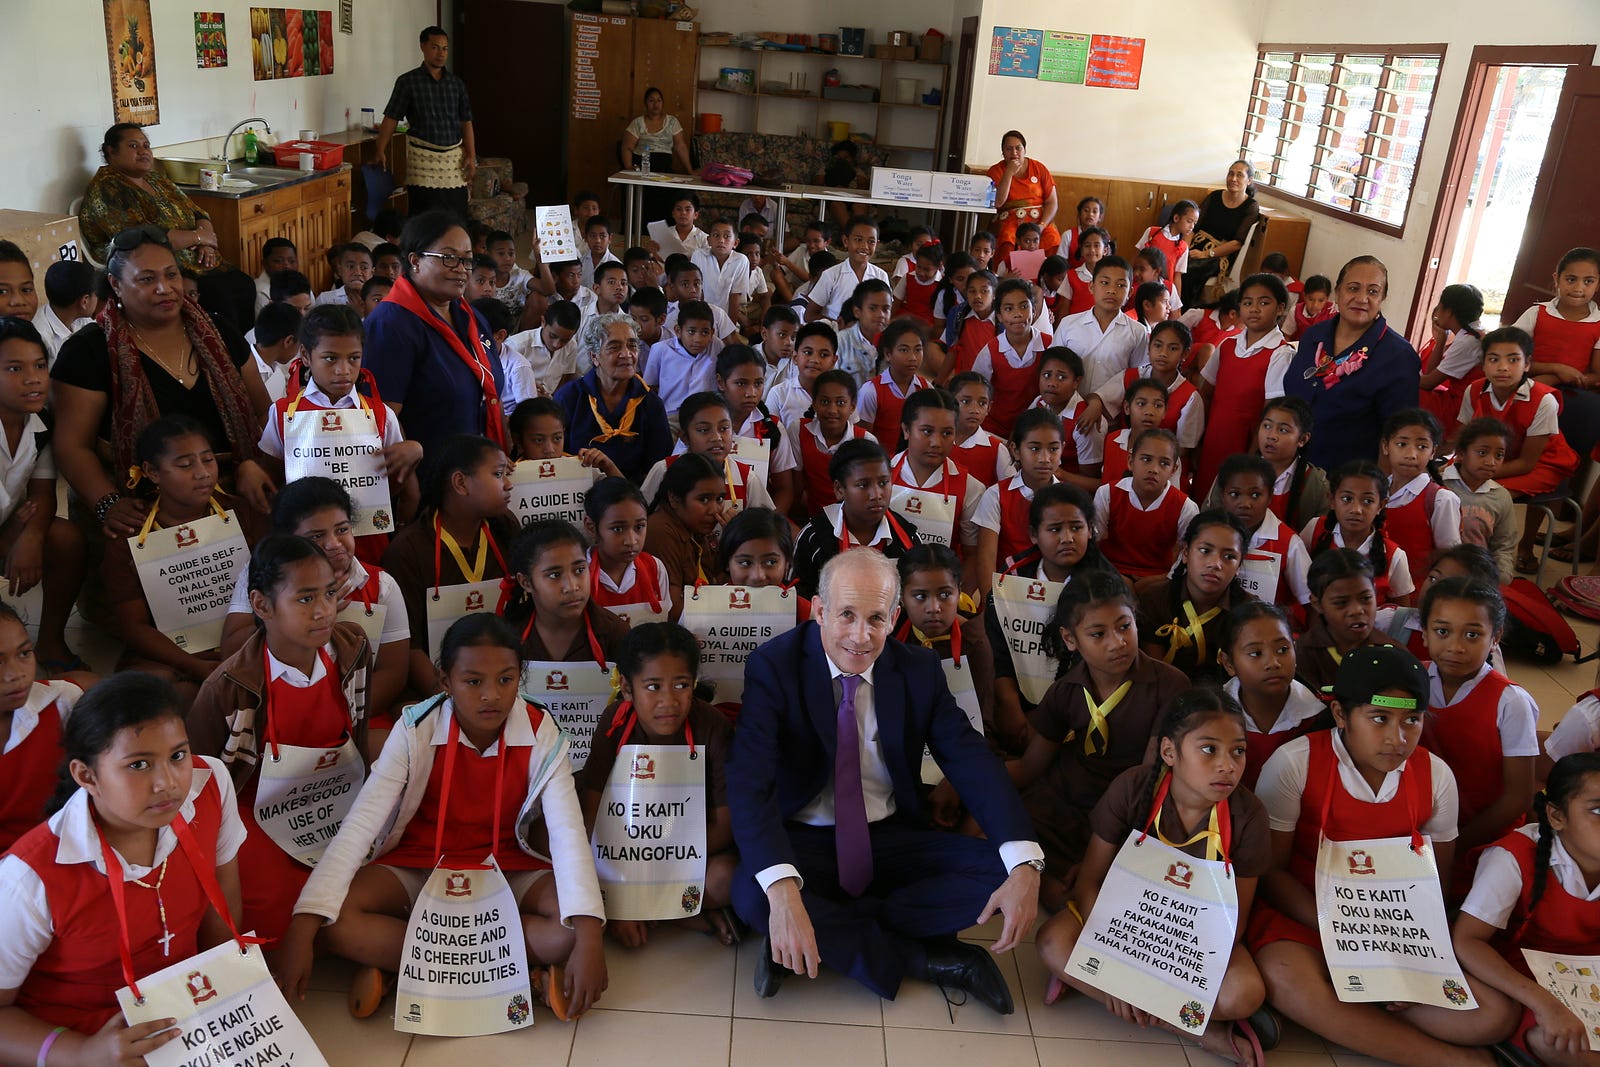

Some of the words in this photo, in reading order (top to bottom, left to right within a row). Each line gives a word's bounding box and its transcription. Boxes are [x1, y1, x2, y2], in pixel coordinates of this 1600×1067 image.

[891, 172, 912, 181] Tonga
[950, 178, 971, 186] Tonga
[294, 447, 330, 458] GUIDE
[520, 498, 528, 509] A
[531, 493, 569, 508] GUIDE
[574, 492, 584, 504] IS
[522, 510, 584, 526] OBEDIENT
[919, 532, 947, 544] OTTO:-
[160, 568, 167, 576] A
[168, 559, 199, 574] GUIDE
[201, 555, 210, 564] IS
[168, 560, 234, 585] CONTROLLED
[178, 586, 188, 594] IN
[191, 580, 210, 590] ALL
[212, 572, 231, 584] SHE
[1250, 580, 1258, 590] IS
[178, 589, 218, 605] THINKS,
[219, 582, 236, 594] SAY
[187, 602, 208, 614] AND
[708, 627, 716, 636] A
[720, 627, 757, 637] GUIDE
[760, 626, 772, 636] IS
[1004, 616, 1009, 630] A
[1012, 618, 1045, 635] GUID
[700, 640, 729, 650] OYAL
[732, 642, 758, 650] AND
[700, 654, 716, 664] BE
[720, 654, 749, 664] TRUS
[552, 702, 558, 710] E
[286, 787, 298, 796] A
[302, 774, 346, 792] GUIDE
[260, 796, 308, 821] MAKES
[312, 782, 351, 802] GOOD
[608, 802, 626, 816] KO
[632, 804, 640, 817] E
[288, 811, 314, 830] USE
[318, 804, 334, 820] OF
[292, 832, 318, 848] HER
[596, 845, 701, 861] TALANGOFUA.
[1143, 889, 1159, 902] KO
[1160, 896, 1169, 906] E
[1335, 886, 1354, 900] KO
[1356, 890, 1366, 900] E
[422, 909, 428, 922] A
[431, 913, 470, 928] GUIDE
[474, 908, 500, 926] HAS
[1164, 912, 1194, 930] ANGA
[1374, 908, 1414, 921] ANGA
[416, 927, 477, 946] COURAGE
[480, 926, 506, 944] AND
[1110, 918, 1122, 927] KI
[1123, 922, 1138, 934] HE
[1140, 929, 1172, 948] KAKAI
[1108, 927, 1128, 941] PEA
[1132, 937, 1174, 960] TOKOUA
[1178, 956, 1204, 973] KIHE
[1336, 939, 1359, 952] MO
[412, 945, 421, 960] IS
[424, 950, 496, 966] CHEERFUL
[499, 944, 511, 959] IN
[1094, 932, 1120, 950] TAHA
[1122, 946, 1150, 963] KAITI
[1152, 960, 1188, 981] KOTOA
[404, 964, 424, 981] ALL
[428, 962, 520, 984] DIFFICULTIES.
[182, 1028, 206, 1050] KO
[208, 1021, 220, 1038] E
[212, 1041, 234, 1063] NE
[234, 1015, 284, 1051] NGĀUE
